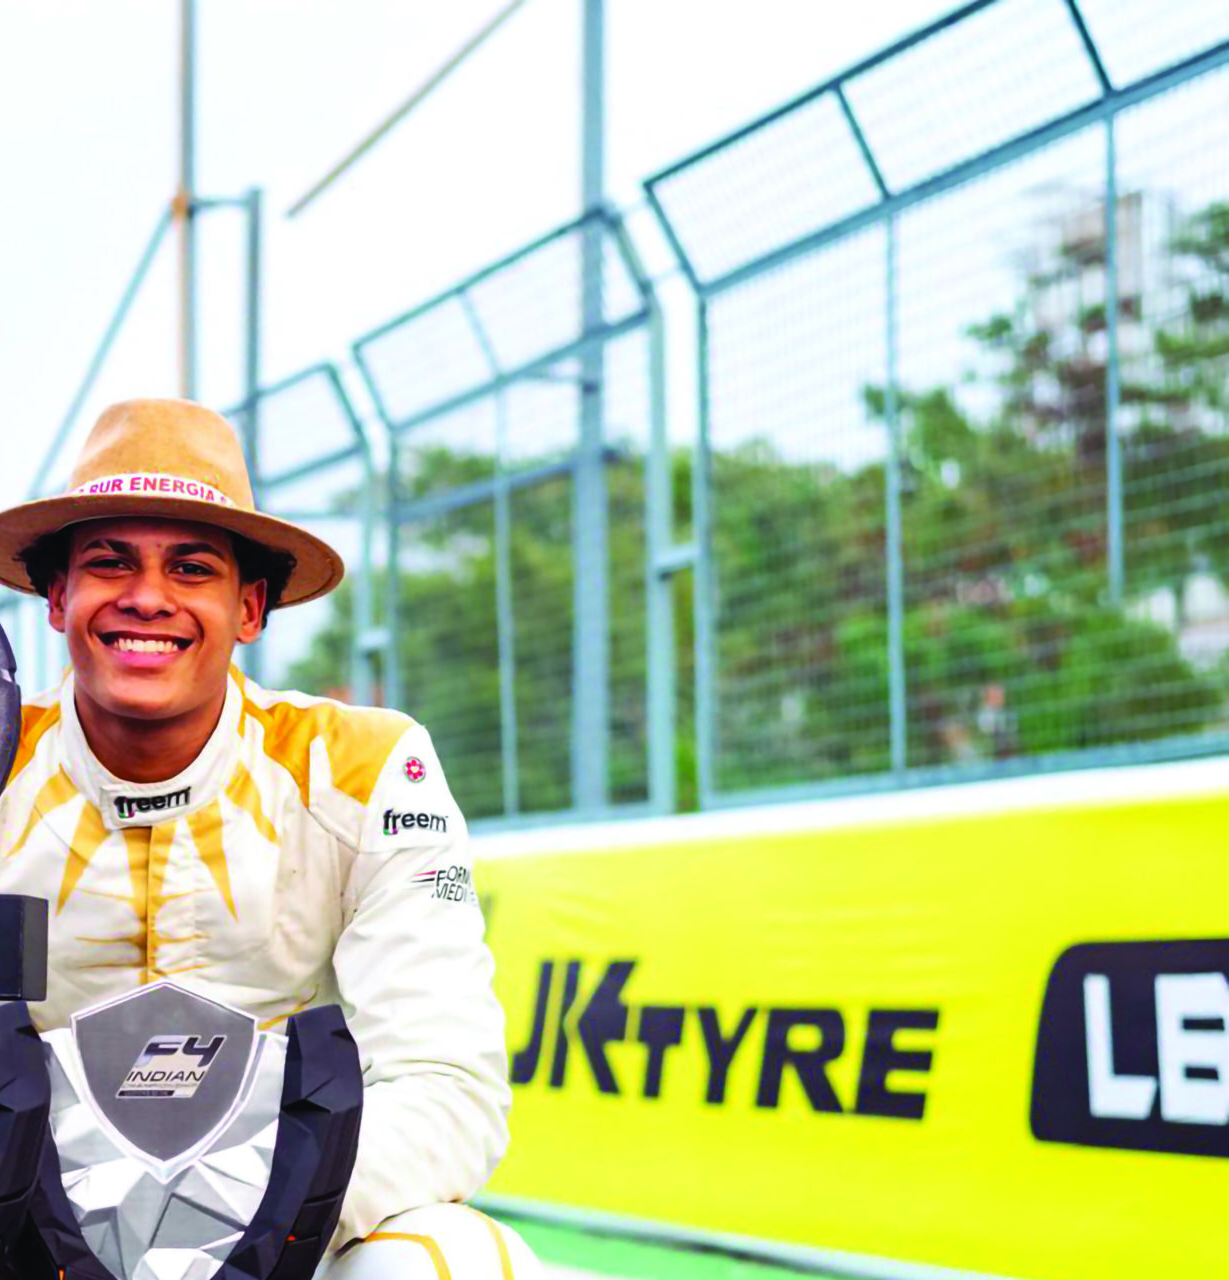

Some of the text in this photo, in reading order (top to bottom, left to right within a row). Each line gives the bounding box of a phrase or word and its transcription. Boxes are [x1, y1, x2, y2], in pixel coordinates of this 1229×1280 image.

[129, 476, 215, 502] ENERGIA
[114, 785, 191, 819] freem
[383, 809, 447, 836] freem
[135, 1035, 227, 1069] F4
[125, 1070, 207, 1083] INDIAN
